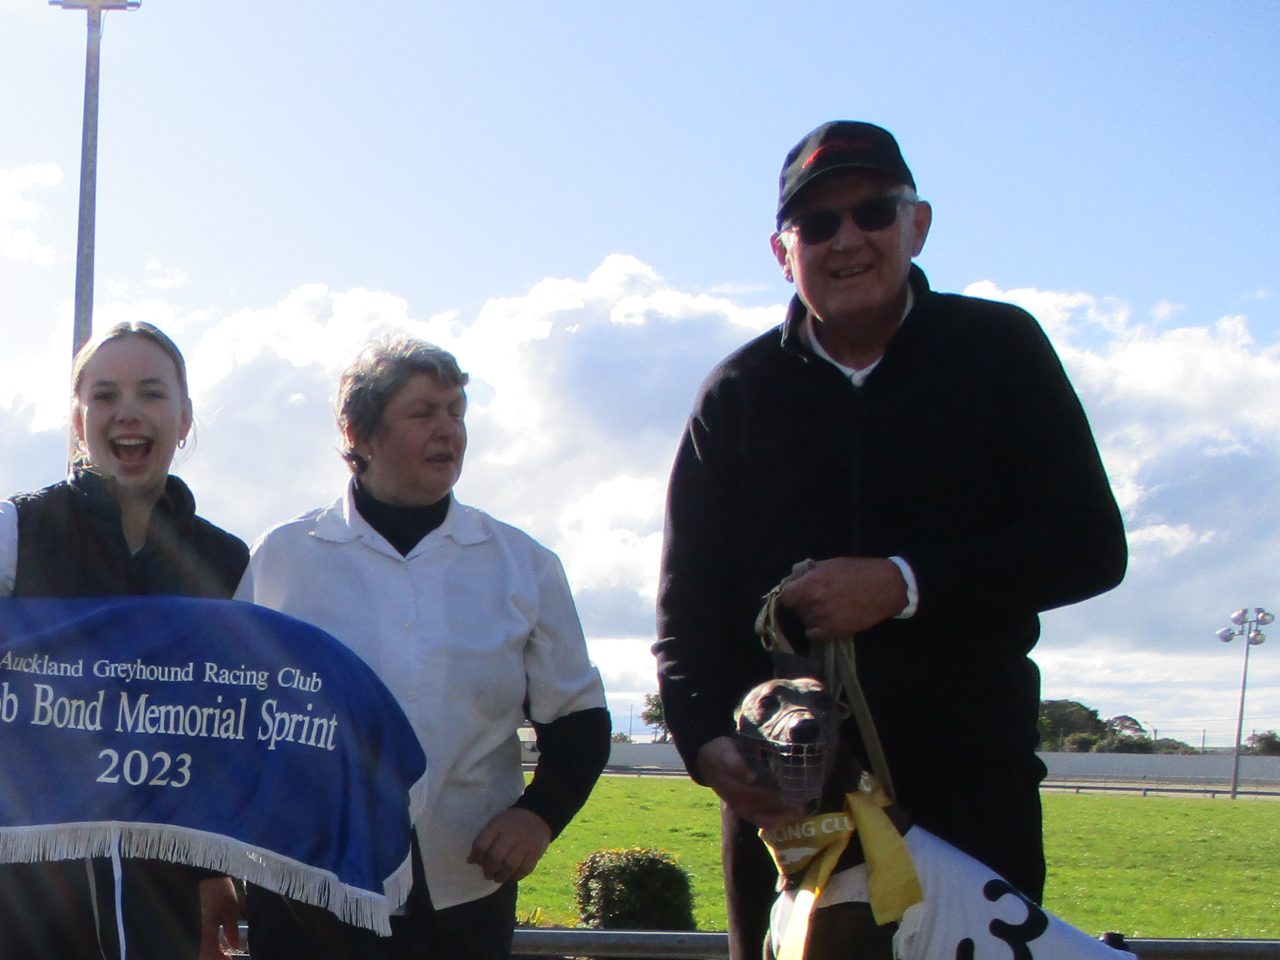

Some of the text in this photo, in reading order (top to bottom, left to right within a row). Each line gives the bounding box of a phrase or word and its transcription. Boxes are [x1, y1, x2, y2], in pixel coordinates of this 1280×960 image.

[93, 658, 194, 683] Greyhound
[203, 662, 269, 691] Racing
[277, 667, 323, 693] Club
[31, 682, 105, 732] Bond
[115, 690, 247, 741] Memorial
[257, 698, 338, 751] Sprint
[95, 748, 192, 788] 2023
